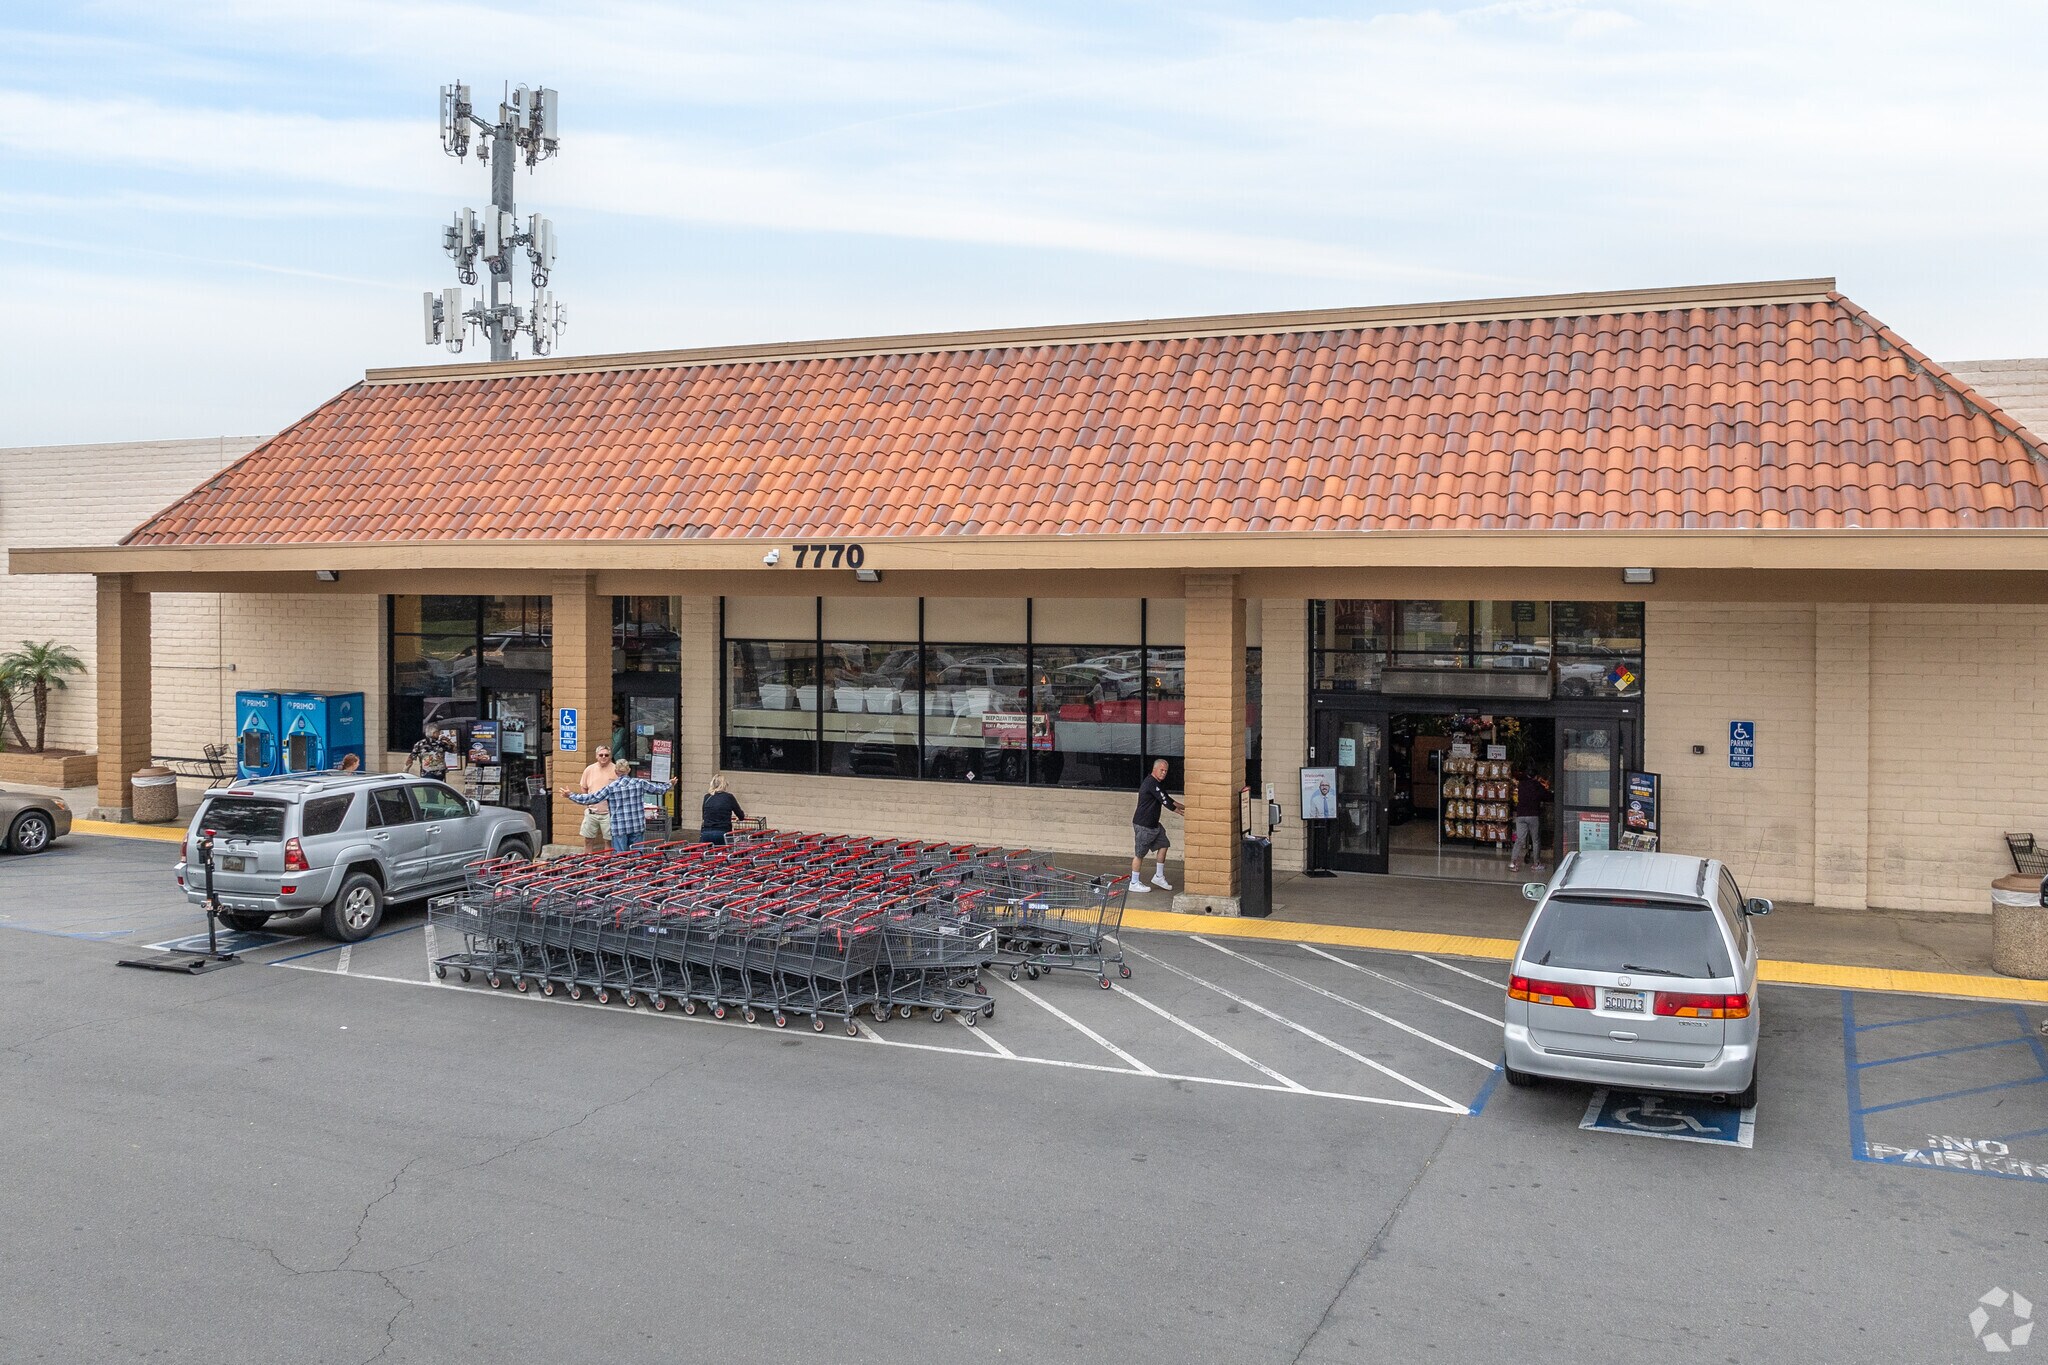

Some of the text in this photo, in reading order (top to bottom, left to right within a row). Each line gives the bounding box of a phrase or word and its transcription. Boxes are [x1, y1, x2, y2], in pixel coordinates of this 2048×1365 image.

[792, 544, 864, 568] 7770
[1040, 675, 1046, 684] 4
[1155, 678, 1162, 688] 3
[1625, 673, 1631, 683] 2
[247, 700, 266, 708] PRIMO
[292, 702, 314, 710] PRIMO
[1605, 996, 1644, 1011] 5CDU713
[1927, 1133, 2010, 1156] NO
